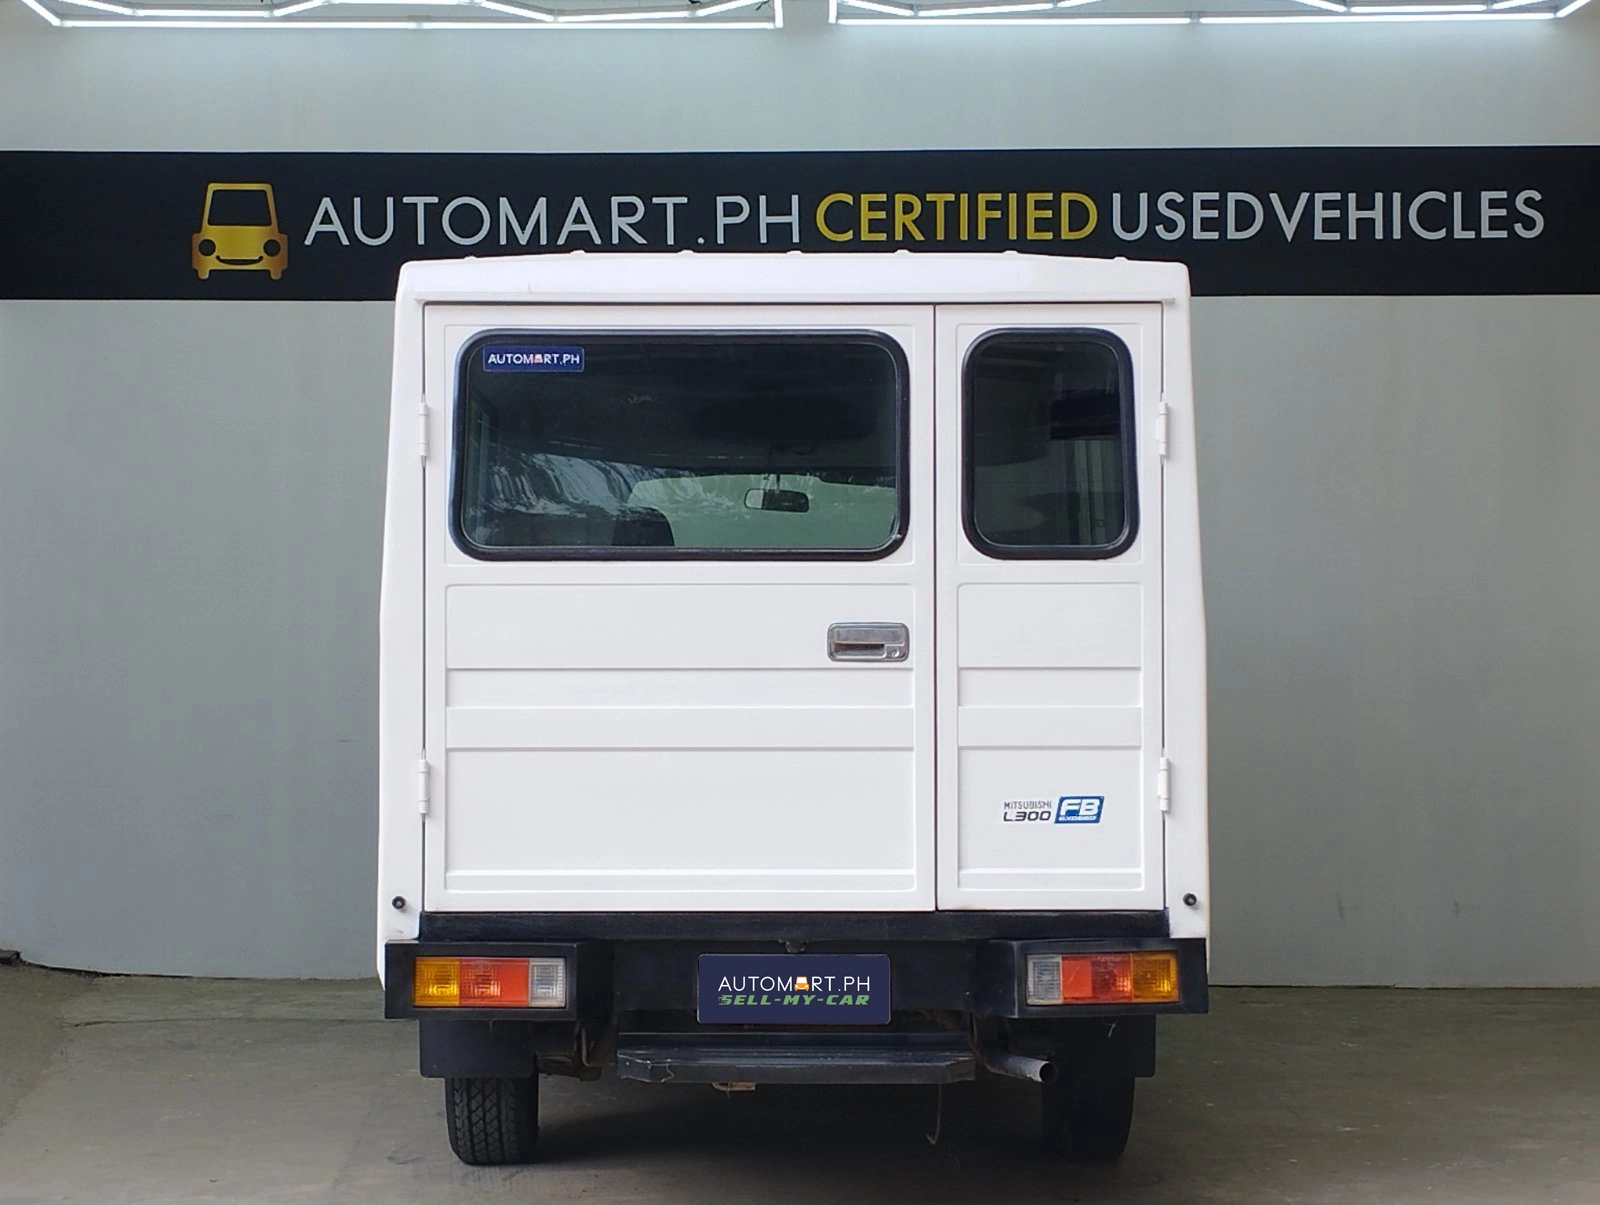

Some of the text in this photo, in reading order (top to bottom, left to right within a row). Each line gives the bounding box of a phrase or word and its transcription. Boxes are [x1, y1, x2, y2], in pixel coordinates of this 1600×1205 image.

[303, 194, 800, 246] AUTOMART.PH
[815, 191, 1098, 242] CERTIFIED
[1003, 800, 1052, 810] MITSUBISHI
[1003, 798, 1101, 822] L300 FB
[717, 994, 871, 1006] SELL-MY-CAR
